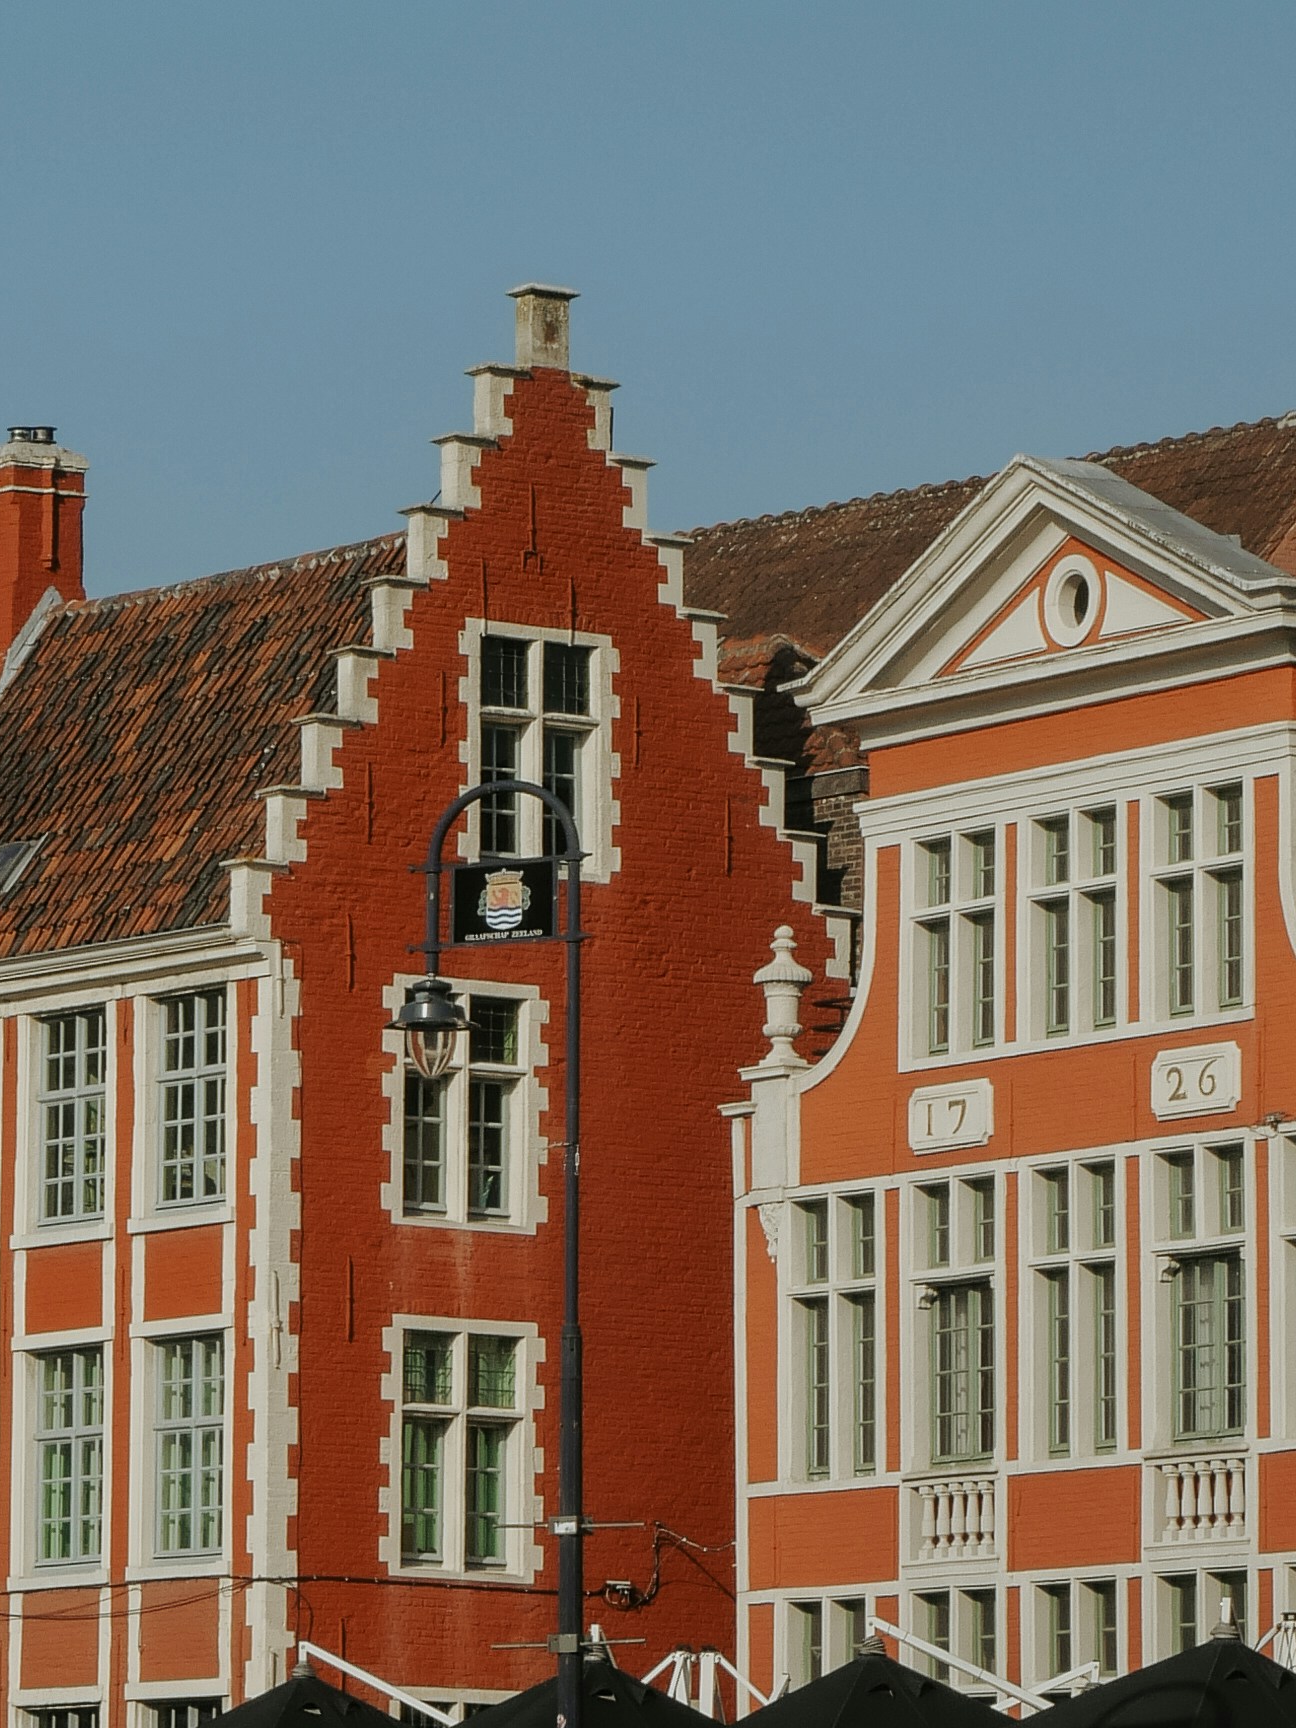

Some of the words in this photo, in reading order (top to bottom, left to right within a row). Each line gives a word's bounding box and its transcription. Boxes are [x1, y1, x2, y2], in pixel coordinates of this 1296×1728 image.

[511, 929, 543, 938] ZEELAND
[925, 1098, 967, 1136] 17
[1165, 1058, 1218, 1102] 26
